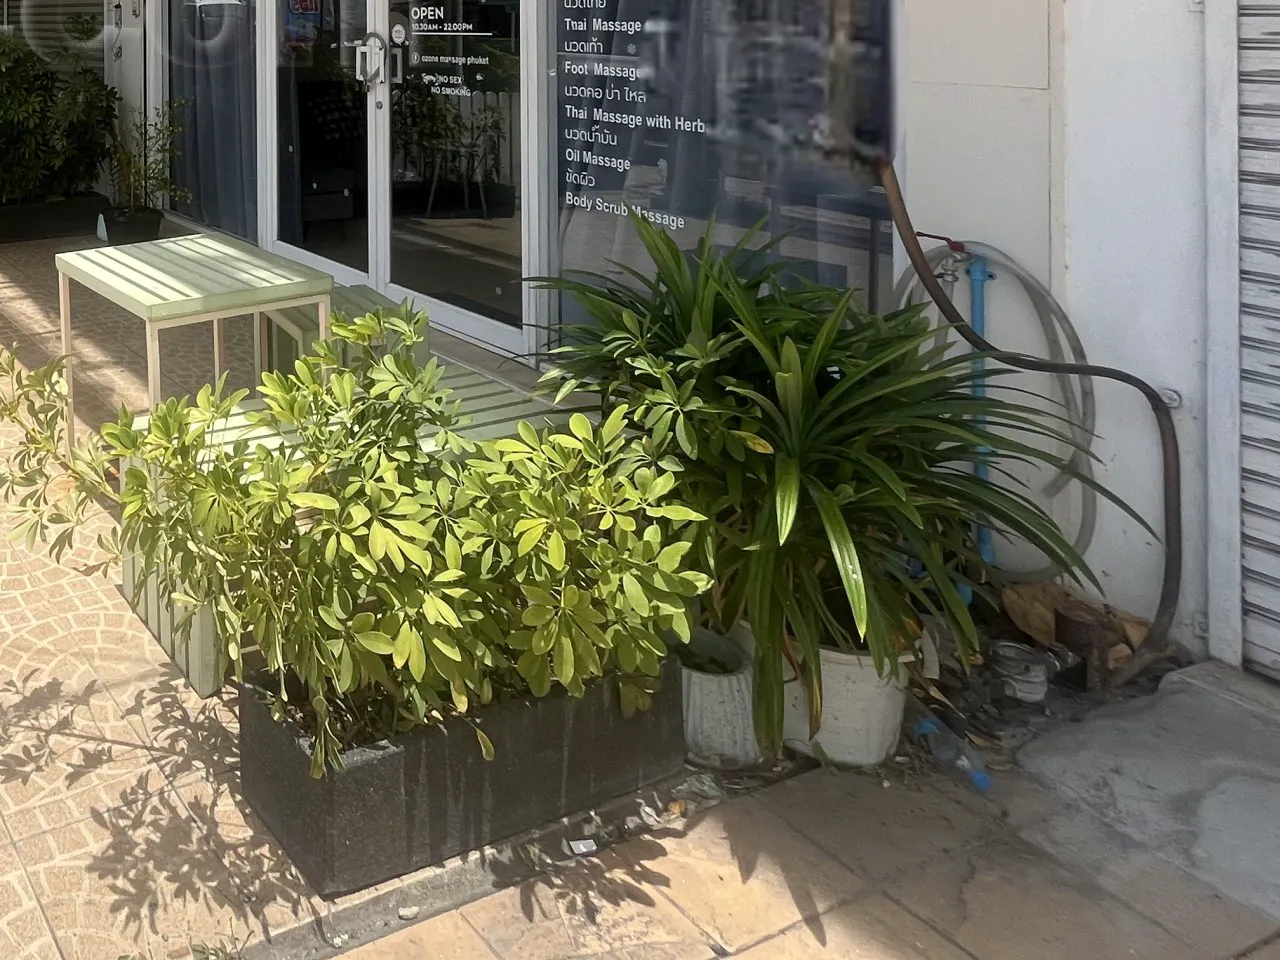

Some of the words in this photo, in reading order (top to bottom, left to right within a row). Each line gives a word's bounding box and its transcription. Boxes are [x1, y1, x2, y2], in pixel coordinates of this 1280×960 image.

[411, 6, 444, 20] OPEN
[592, 18, 642, 35] Massage
[564, 37, 604, 54] นวดเท้า
[467, 55, 489, 66] phuket
[449, 75, 462, 84] SEX
[564, 61, 589, 75] Foot
[594, 63, 641, 81] Massage
[441, 86, 472, 97] SMOKING
[564, 85, 603, 99] นวดคอ
[606, 84, 621, 101] บ่า
[565, 105, 588, 119] Thai
[593, 108, 642, 128] Massage
[645, 114, 671, 129] with
[565, 125, 617, 146] นวดน้ำมัน
[565, 148, 580, 162] Oil
[583, 150, 631, 172] Massage
[565, 168, 595, 187] ขัดผิว
[565, 192, 593, 212] Body
[596, 198, 628, 216] Scrub
